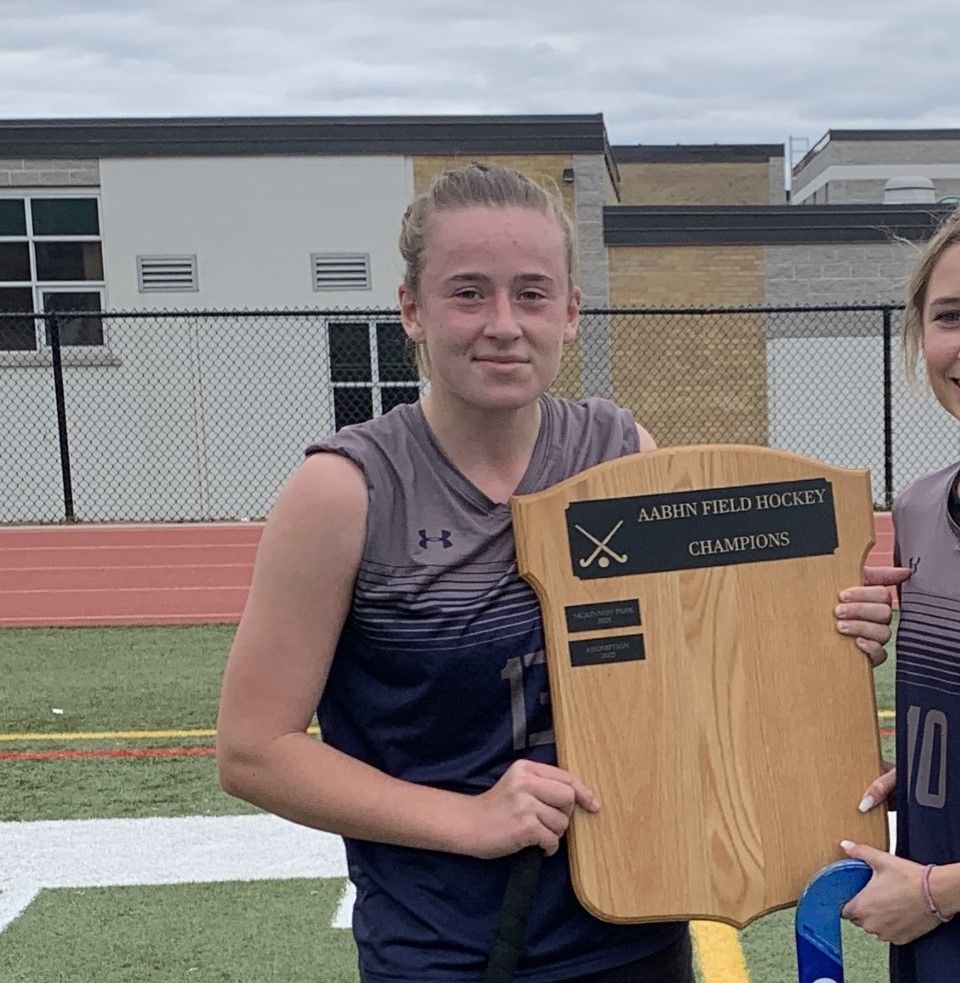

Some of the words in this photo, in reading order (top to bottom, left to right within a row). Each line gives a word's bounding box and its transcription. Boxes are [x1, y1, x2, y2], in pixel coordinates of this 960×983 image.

[638, 502, 698, 522] AABHN
[702, 497, 752, 516] FIELD
[755, 488, 826, 510] HOCKEY
[688, 531, 790, 557] CHAMPIONS
[907, 705, 948, 808] 10
